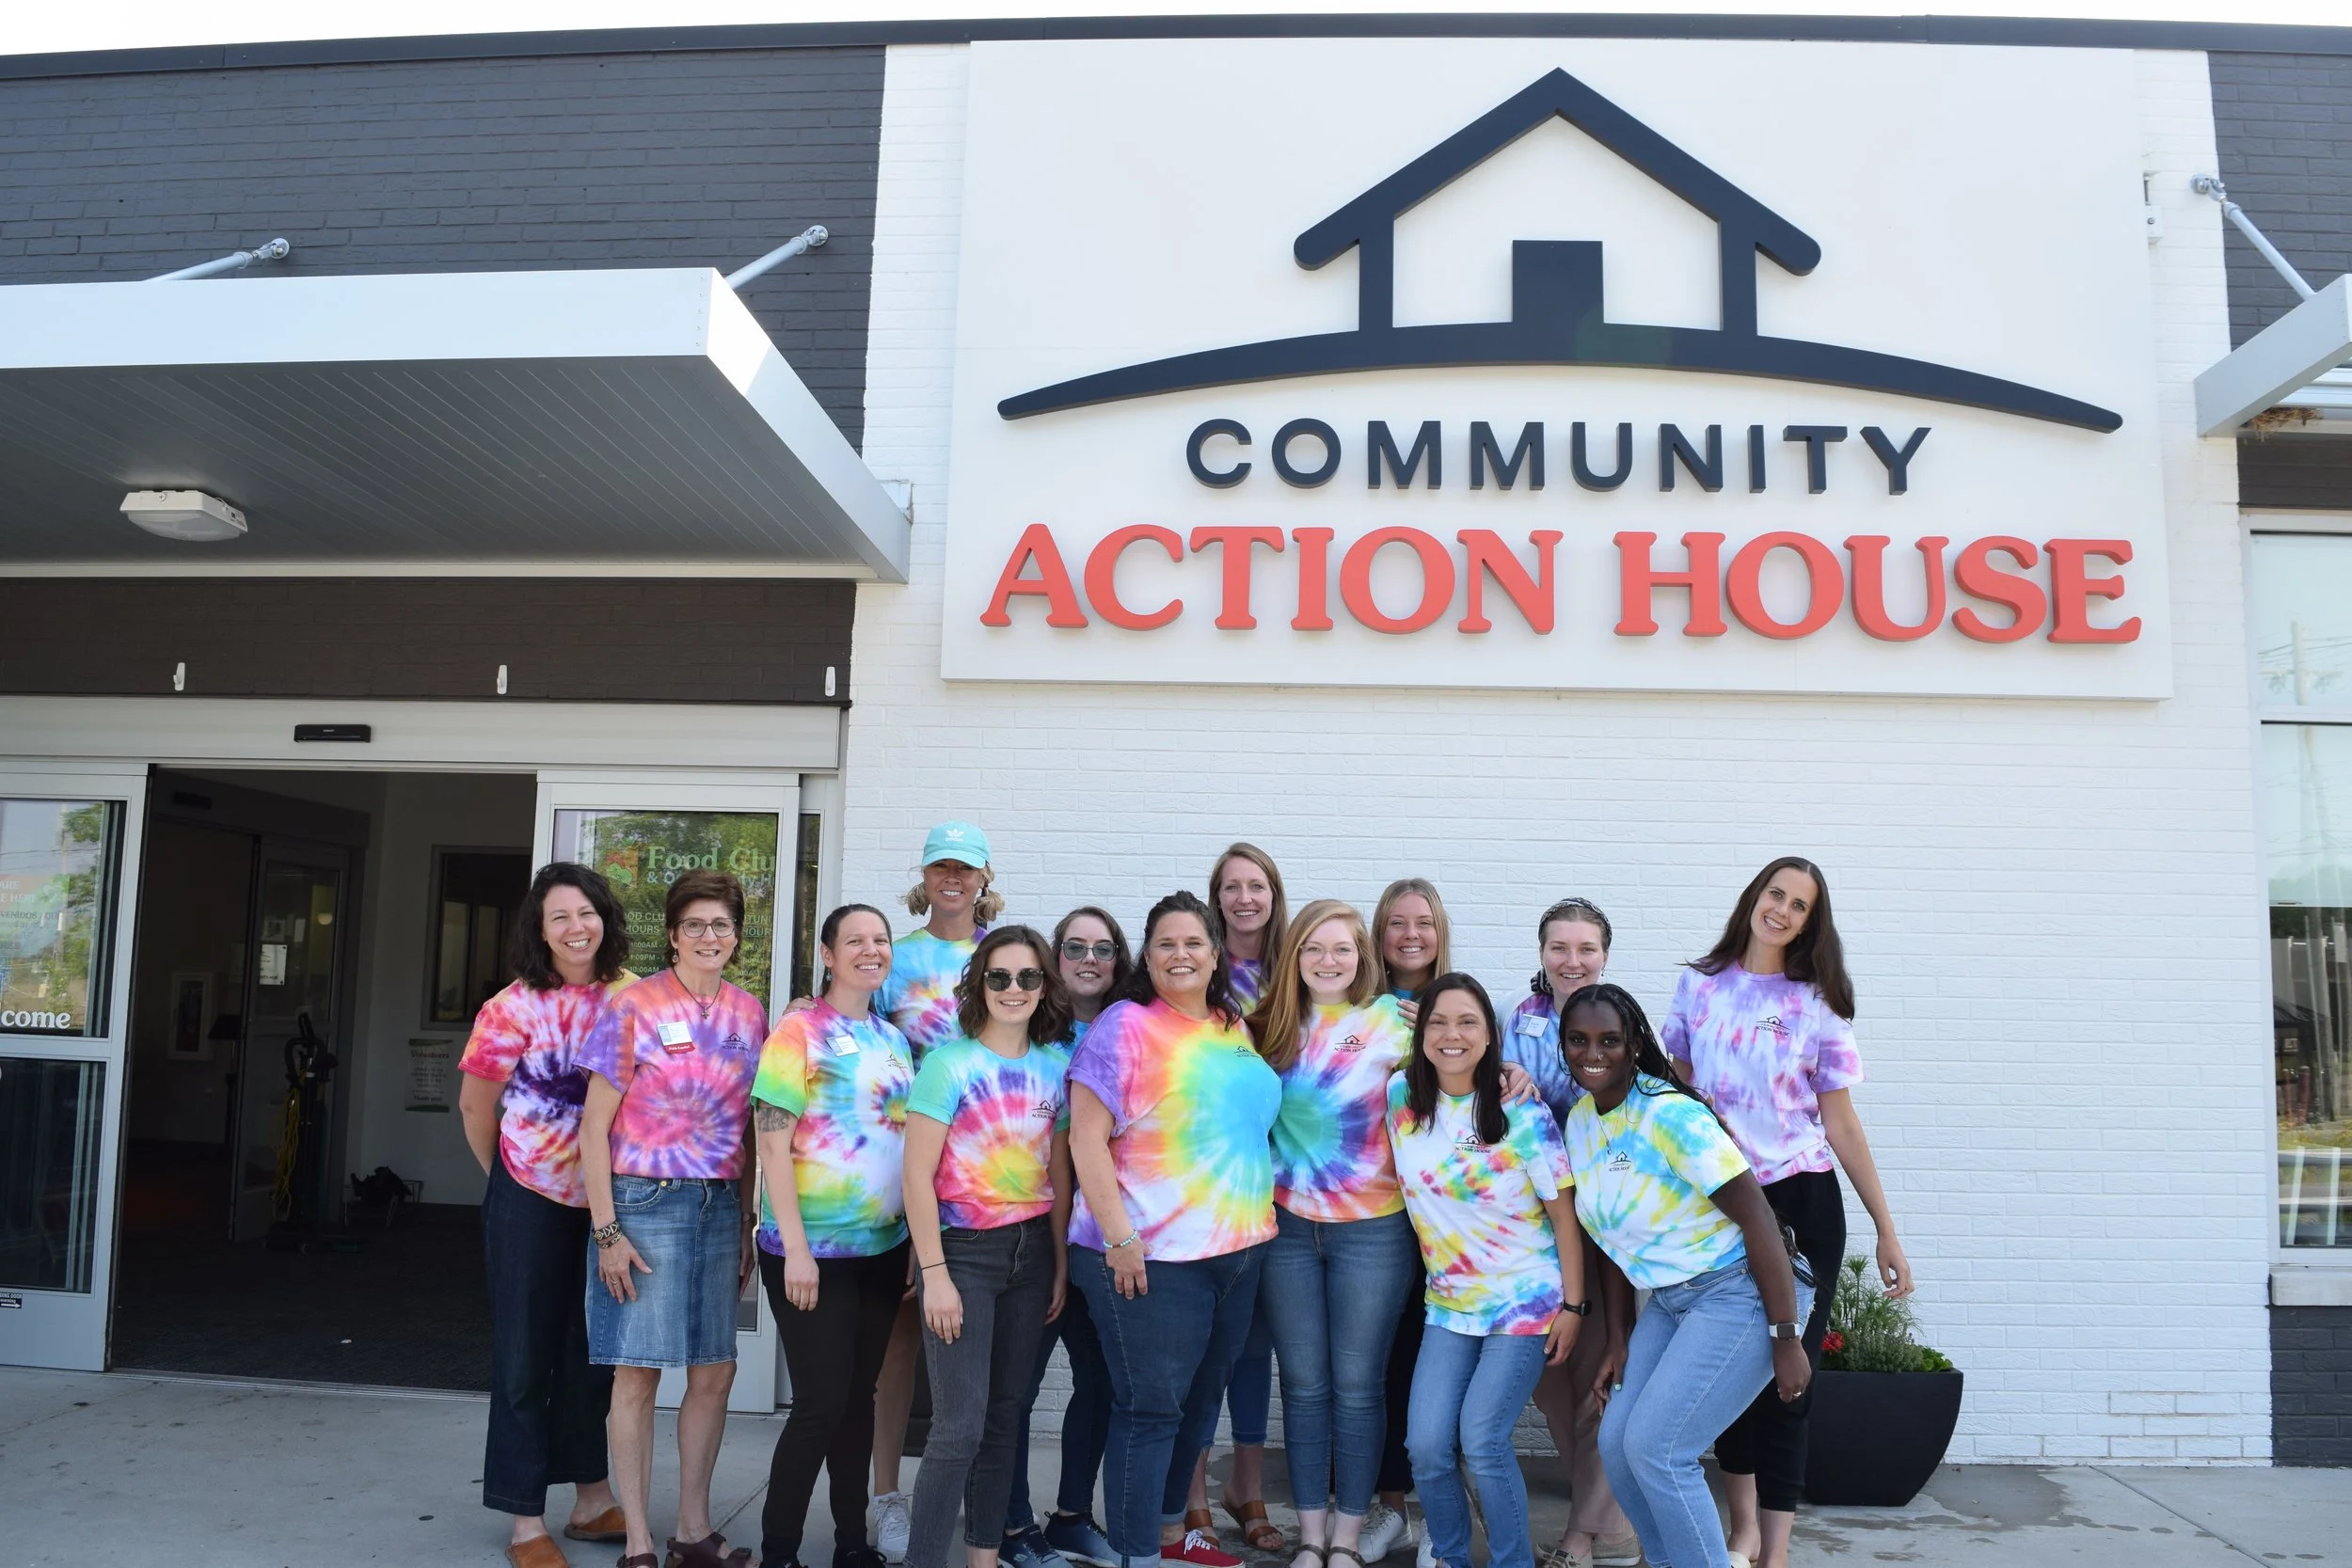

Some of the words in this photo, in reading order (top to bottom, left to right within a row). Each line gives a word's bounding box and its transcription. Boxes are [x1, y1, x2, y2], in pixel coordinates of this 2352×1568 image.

[1186, 419, 1931, 495] COMMUNITY
[980, 523, 1565, 633] ACTION
[1614, 531, 2142, 643] HOUSE
[647, 846, 719, 870] Food
[1, 1009, 72, 1029] come
